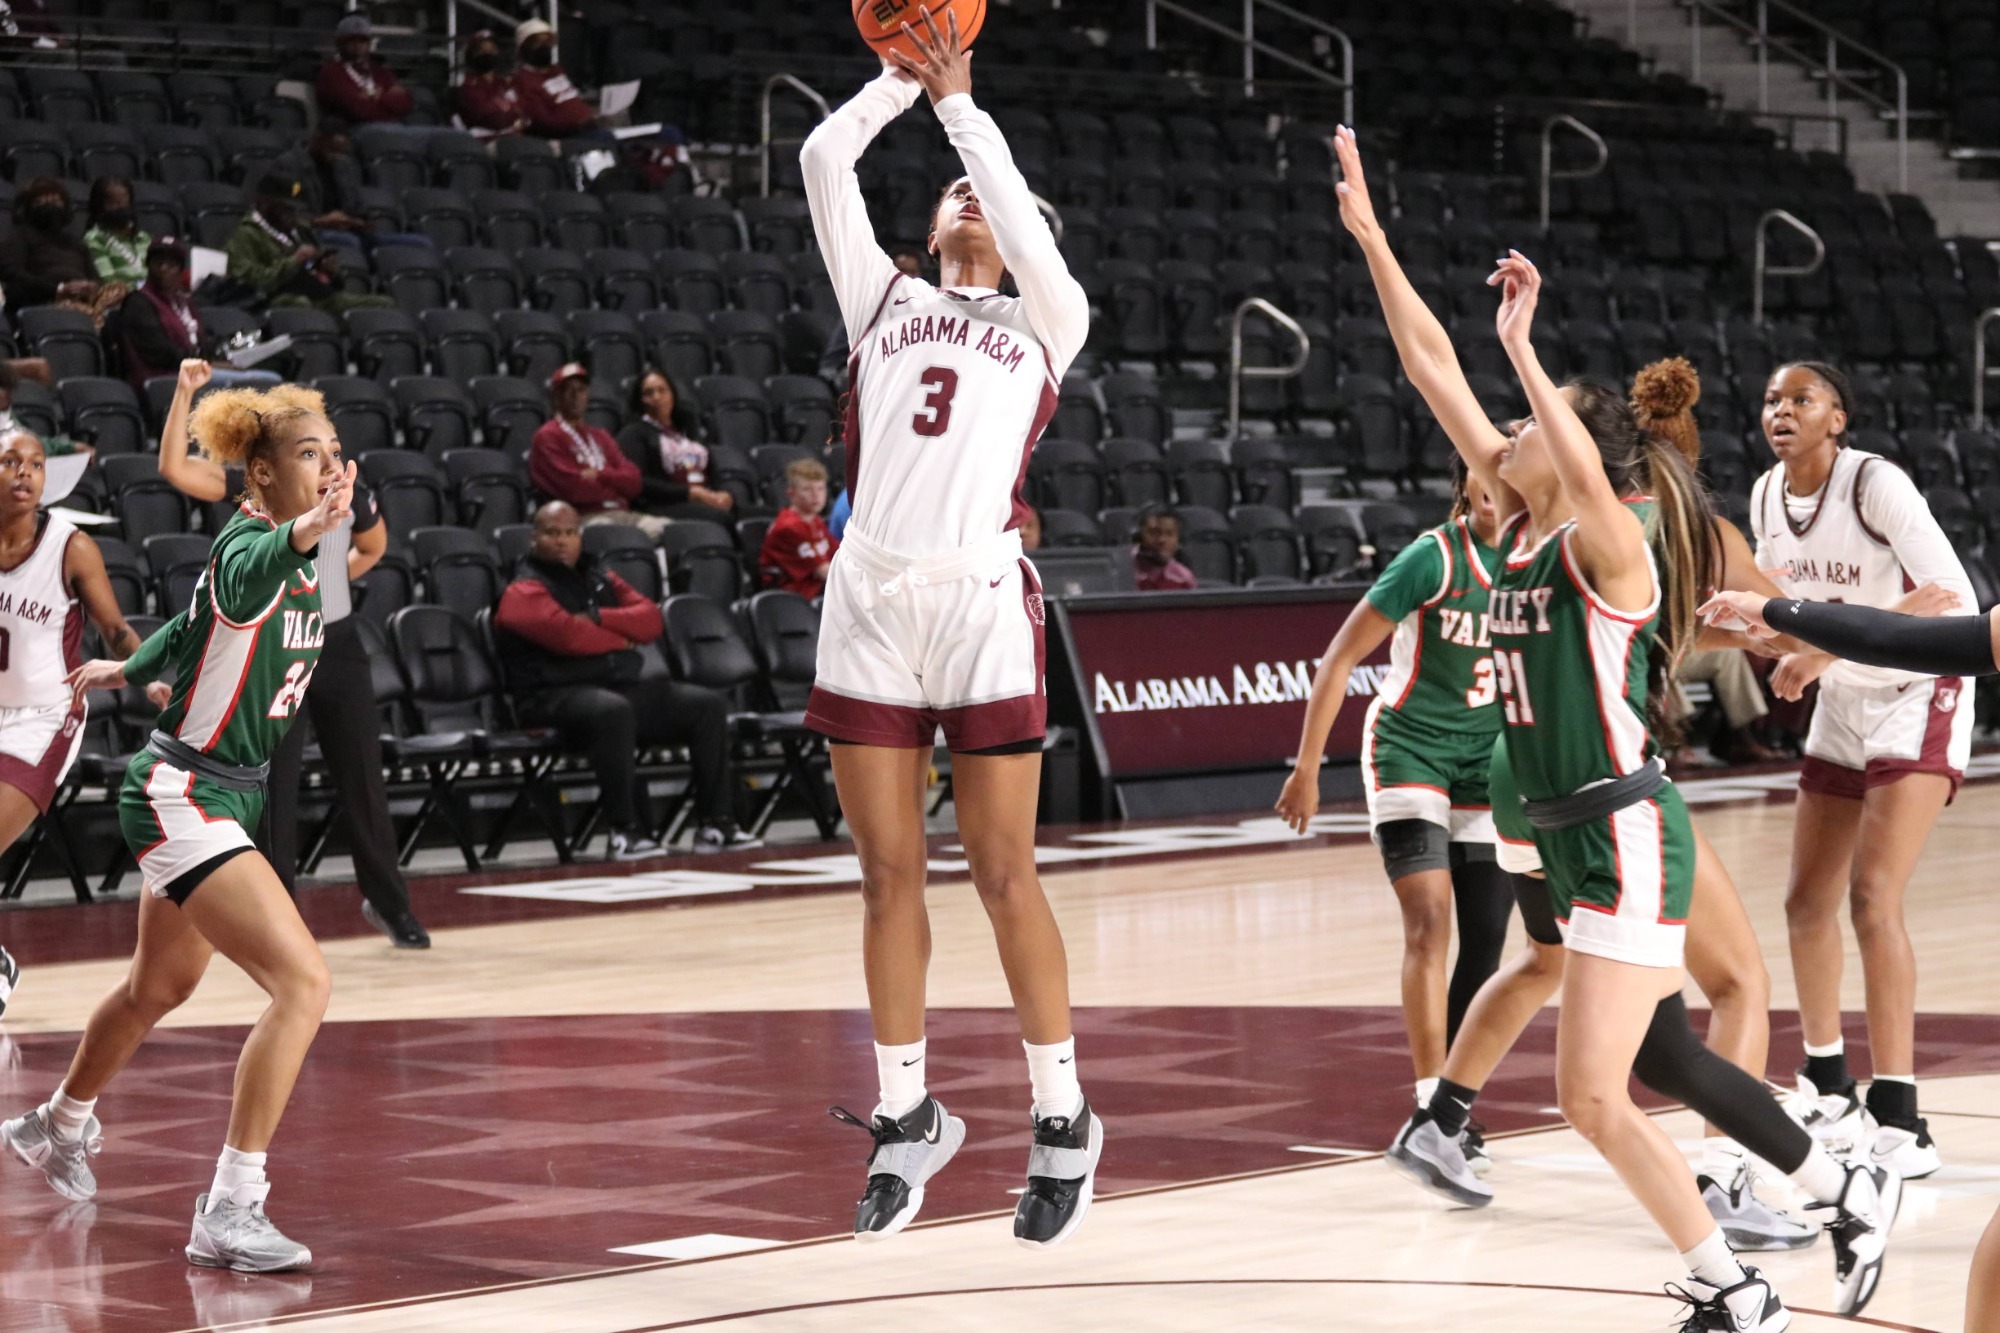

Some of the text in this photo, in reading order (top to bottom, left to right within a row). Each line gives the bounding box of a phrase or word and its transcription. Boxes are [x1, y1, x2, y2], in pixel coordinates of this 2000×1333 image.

[881, 315, 1025, 373] ALABAMA A&M
[911, 365, 960, 437] 3
[1826, 560, 1861, 587] A&M
[16, 597, 52, 626] A&M
[1438, 608, 1492, 648] VAL
[1488, 587, 1552, 634] LLEY
[1095, 671, 1230, 713] ALABAMA
[1233, 659, 1315, 704] A&M
